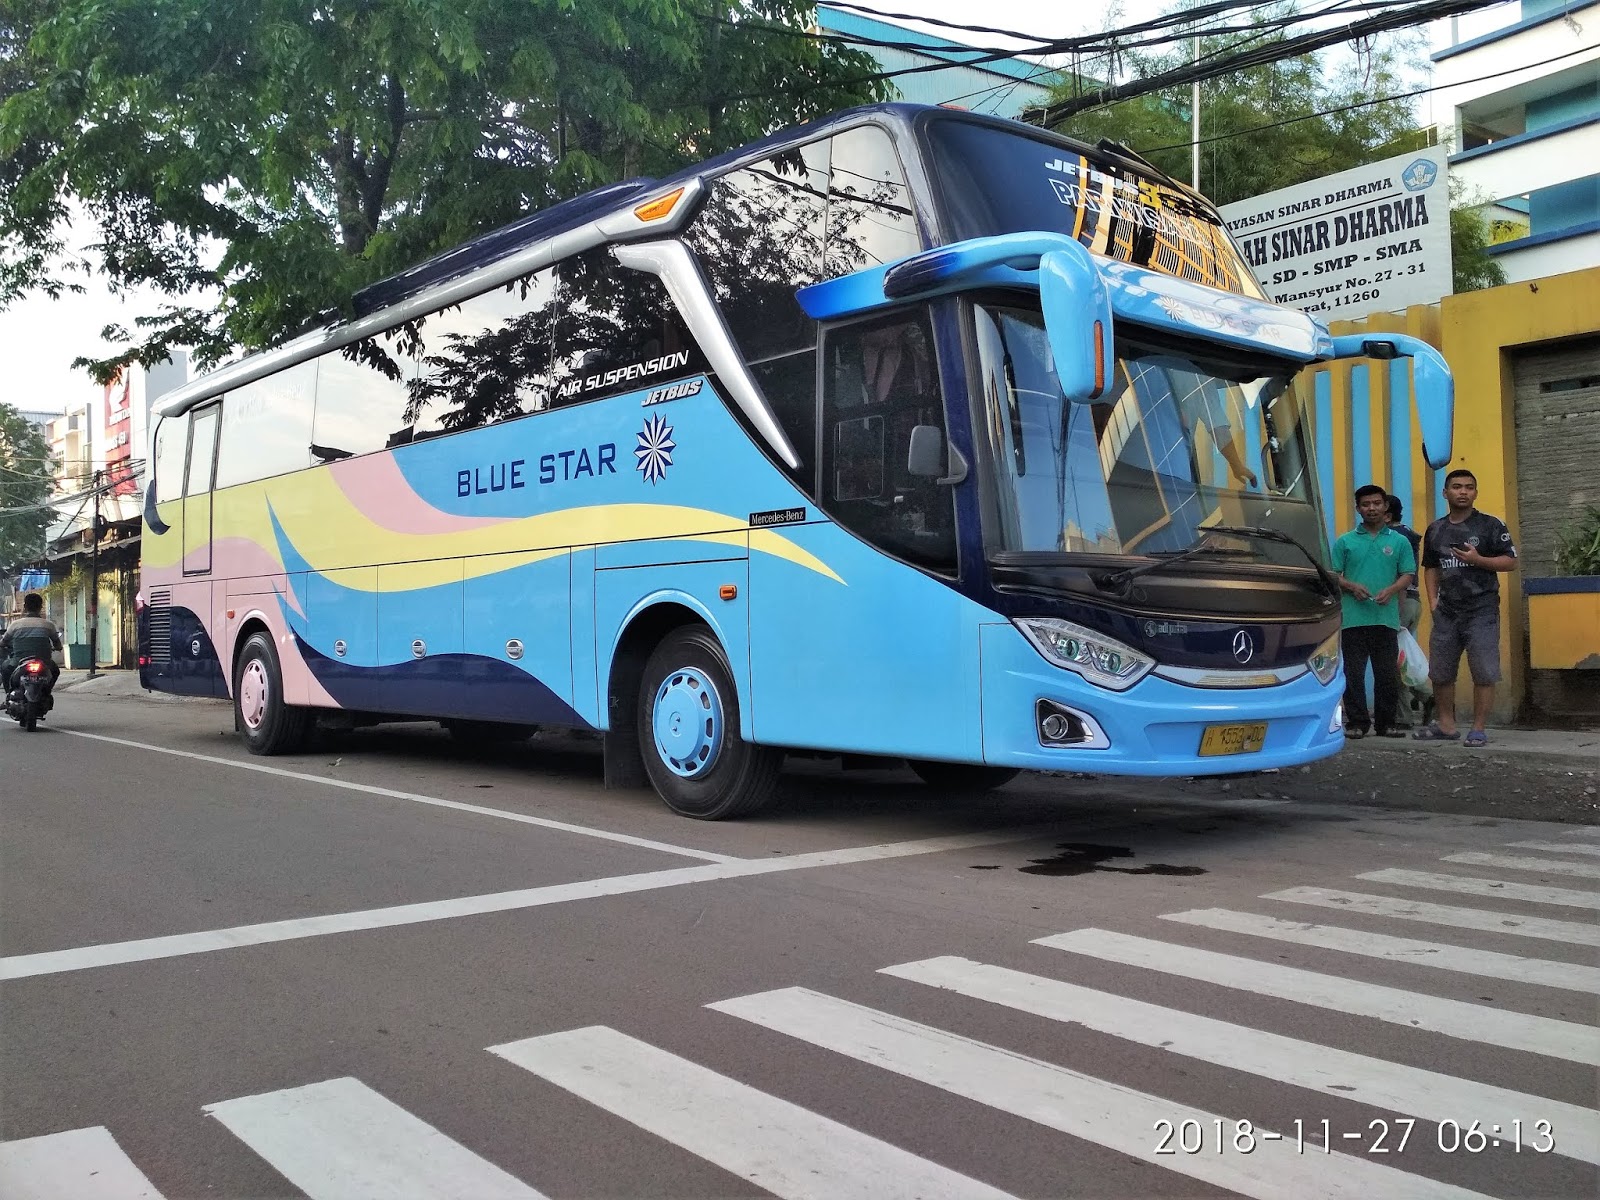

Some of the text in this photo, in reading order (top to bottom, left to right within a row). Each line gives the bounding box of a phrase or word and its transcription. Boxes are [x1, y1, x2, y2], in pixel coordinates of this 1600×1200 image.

[1278, 198, 1321, 218] SINAR
[1324, 178, 1393, 205] DHARMA
[1272, 220, 1330, 262] SINAR
[1334, 194, 1429, 246] DHARMA
[1273, 269, 1297, 285] SD
[1313, 254, 1358, 276] SMP
[1376, 239, 1423, 261] SMA
[1274, 283, 1342, 304] Mansyur
[1407, 262, 1426, 275] 31
[1335, 289, 1380, 307] 11260
[556, 350, 690, 399] AIR SUSPENSION
[641, 380, 704, 407] JETBUS
[457, 442, 617, 498] BLUE STAR
[751, 510, 804, 525] Mercedes-Benz
